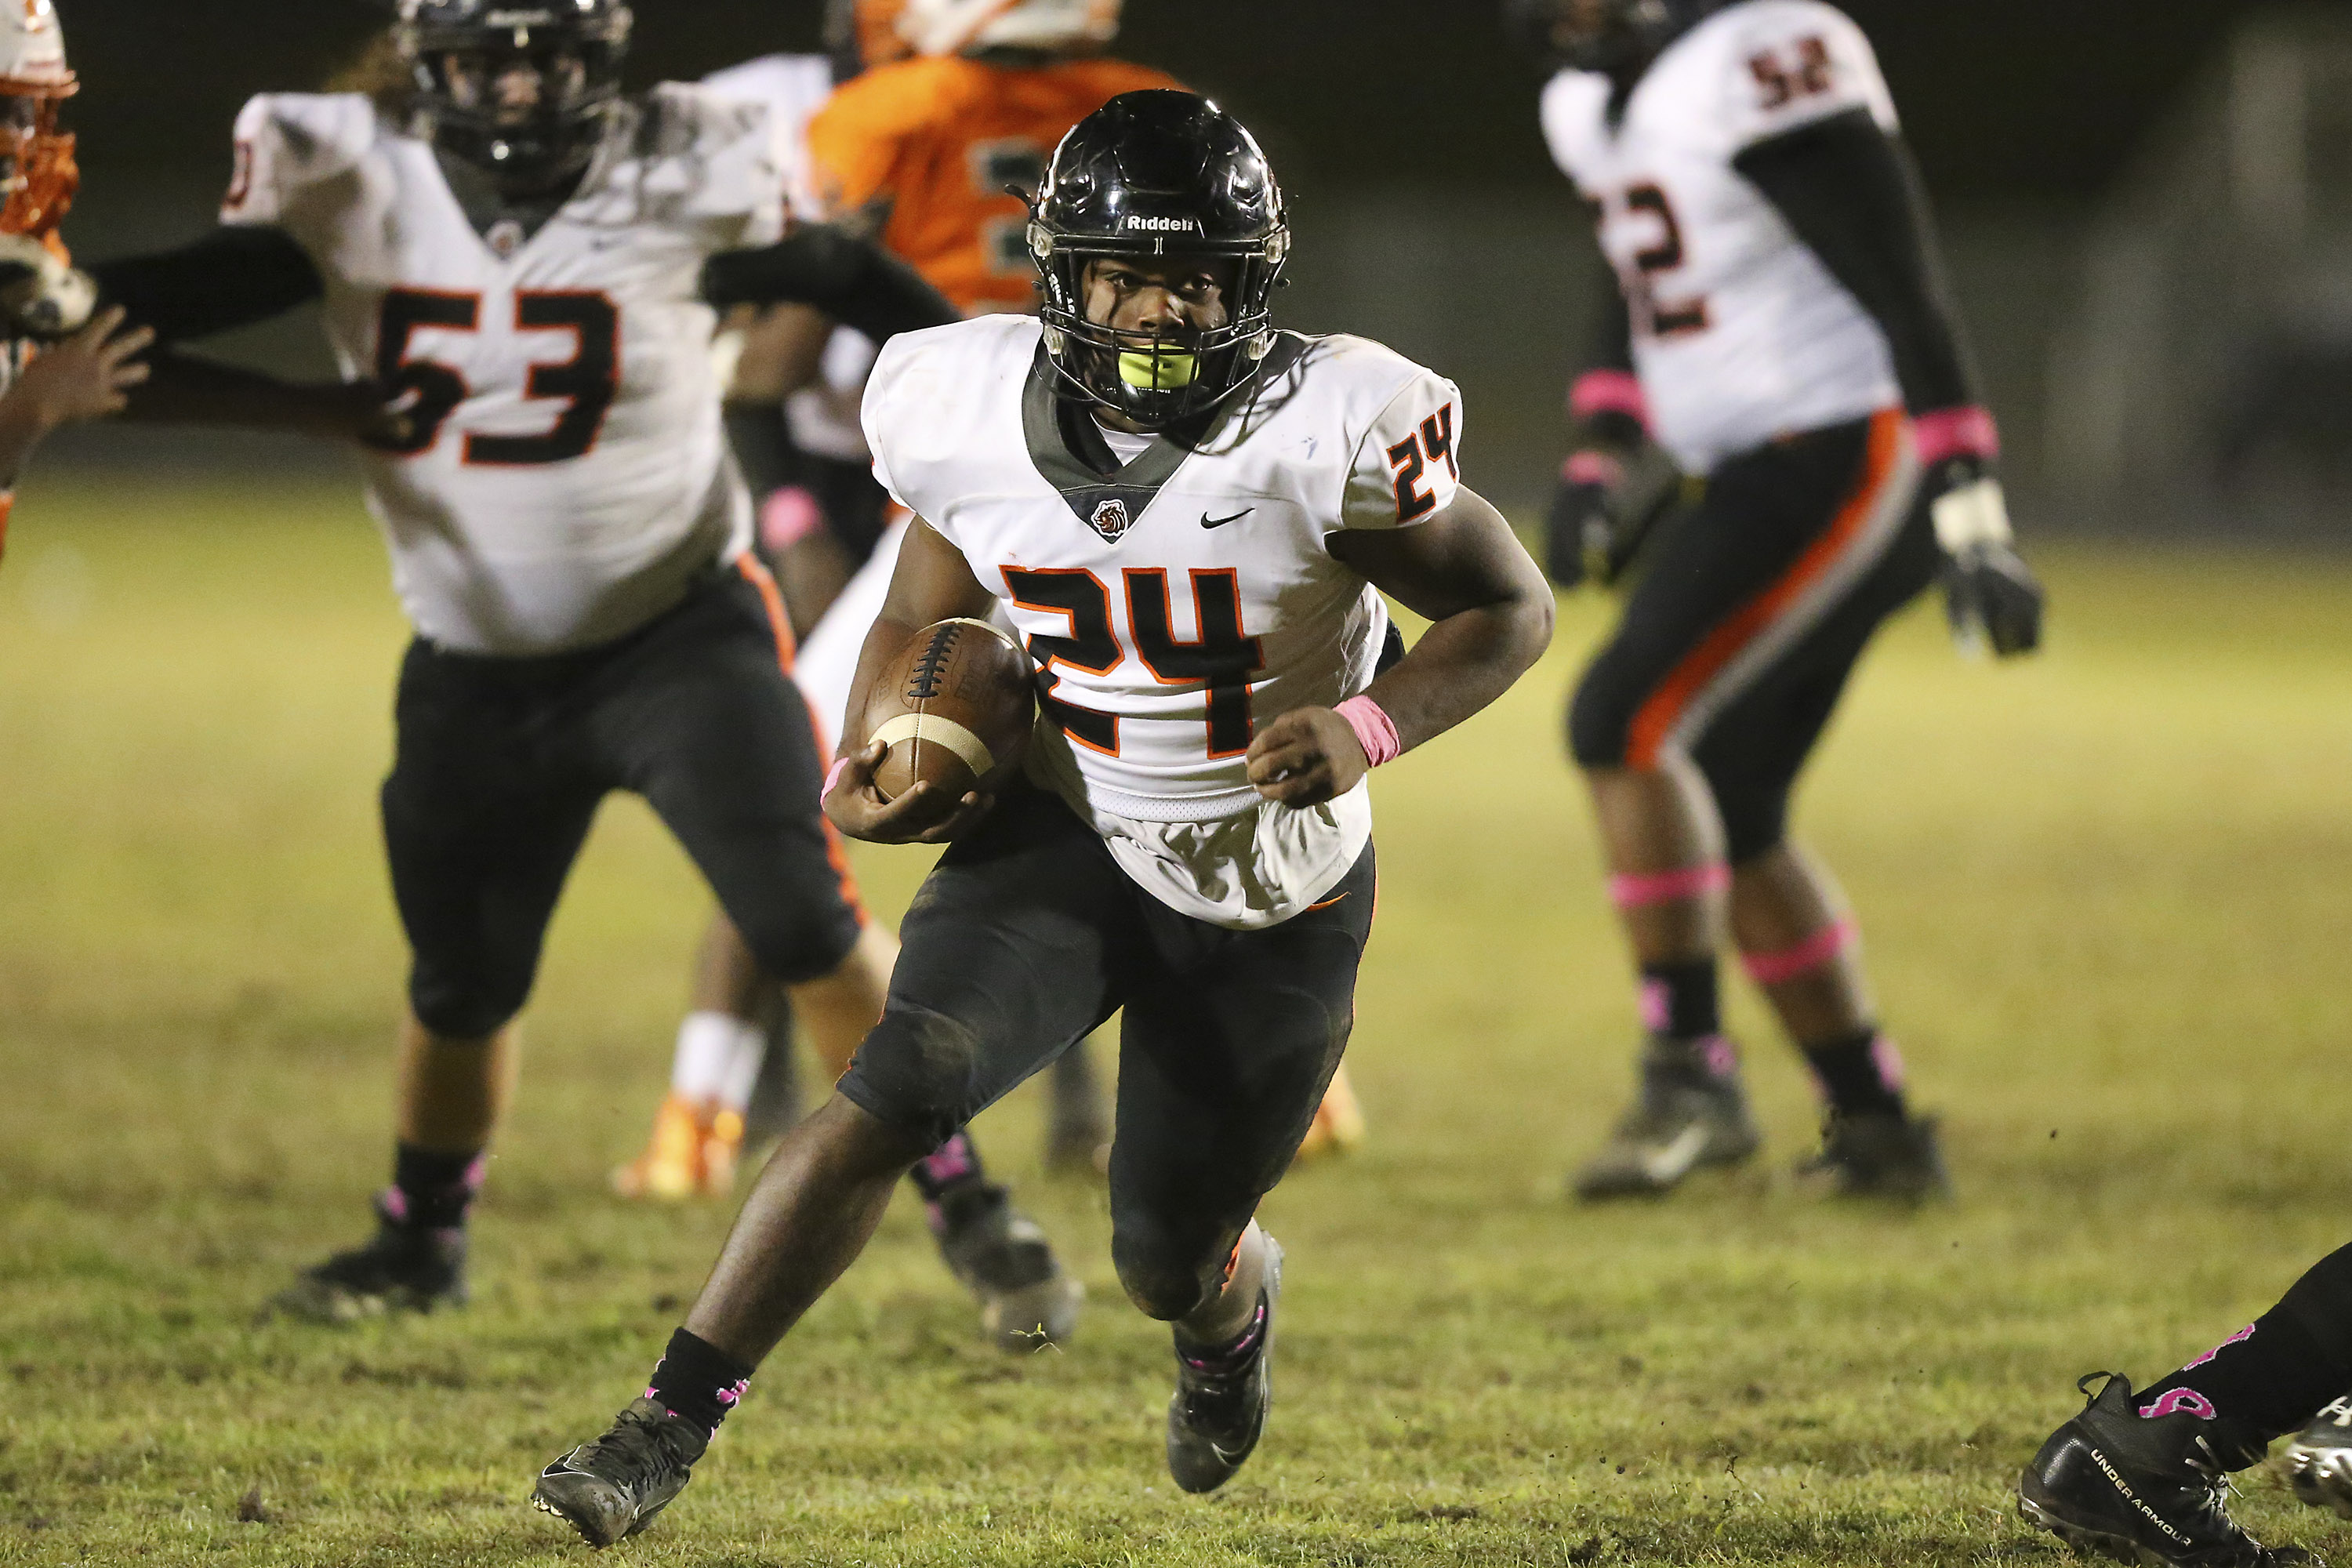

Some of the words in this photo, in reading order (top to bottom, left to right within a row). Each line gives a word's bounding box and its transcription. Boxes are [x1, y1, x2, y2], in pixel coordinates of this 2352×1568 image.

[1127, 215, 1193, 230] Riddell
[375, 287, 622, 467] 53
[1386, 401, 1457, 525] 24
[999, 564, 1265, 760] 24
[2089, 1448, 2133, 1499] UNDER
[2131, 1498, 2192, 1547] ARMOUR
